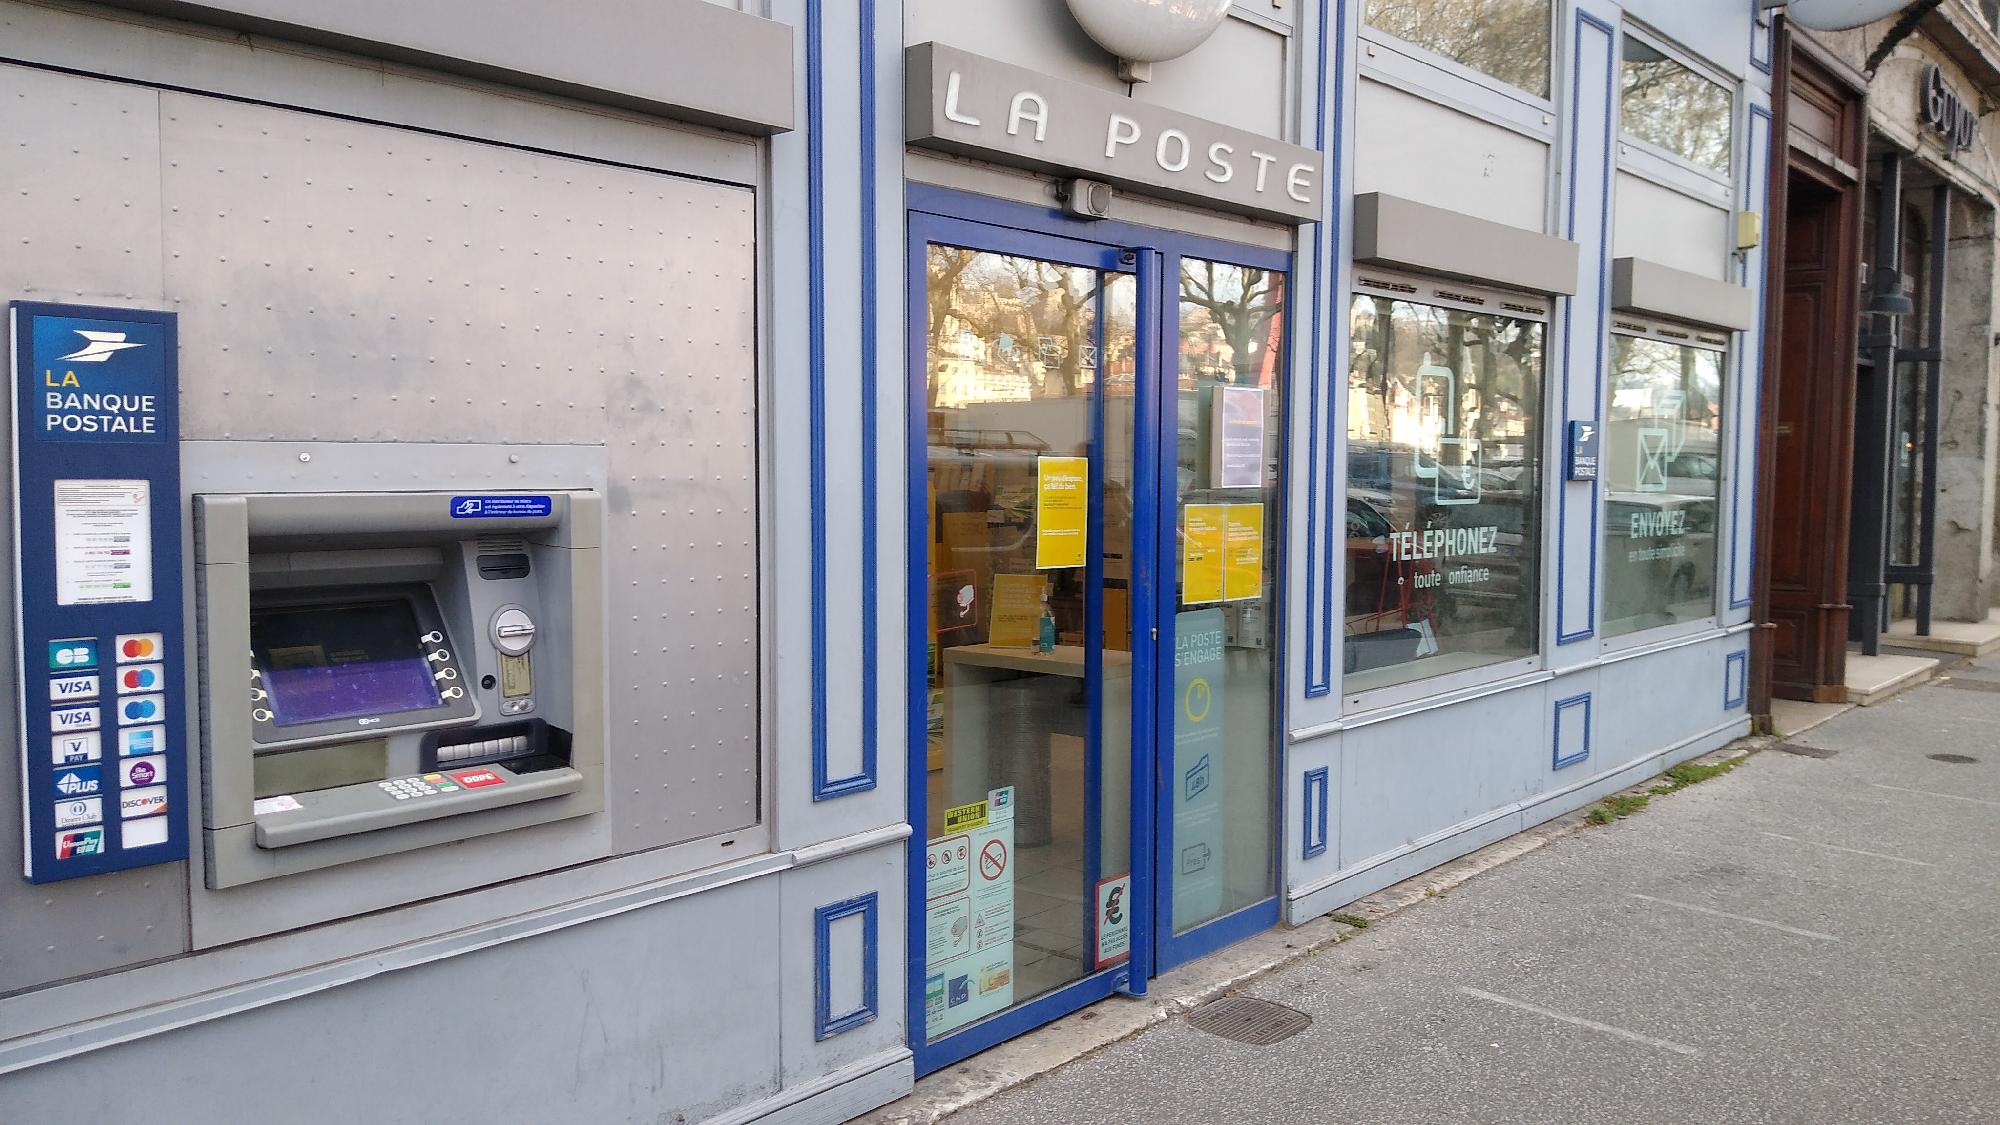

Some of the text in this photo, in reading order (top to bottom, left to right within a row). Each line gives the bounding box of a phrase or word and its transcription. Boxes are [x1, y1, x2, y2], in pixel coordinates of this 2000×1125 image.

[945, 71, 1316, 203] LA POSTE
[45, 369, 80, 388] LA
[46, 392, 156, 414] BANQUE
[46, 414, 156, 433] POSTALE
[1575, 456, 1596, 466] BANQUE
[1575, 467, 1596, 476] POSTALE
[1630, 510, 1686, 538] ENVOYEZ
[1389, 521, 1498, 562] TÉLÉPHONEZ
[1414, 570, 1440, 588] toute
[1175, 630, 1222, 650] LA POSTE
[55, 647, 90, 665] CB
[1174, 646, 1222, 667] S'ENGAGE
[56, 680, 92, 694] VISA
[58, 711, 92, 725] VISA
[70, 741, 82, 752] V
[69, 754, 84, 763] PAY
[131, 769, 154, 780] Smart
[68, 779, 99, 794] PLUS
[122, 796, 165, 809] DISCOVER
[947, 805, 981, 818] WESTERN
[957, 811, 981, 823] UNION
